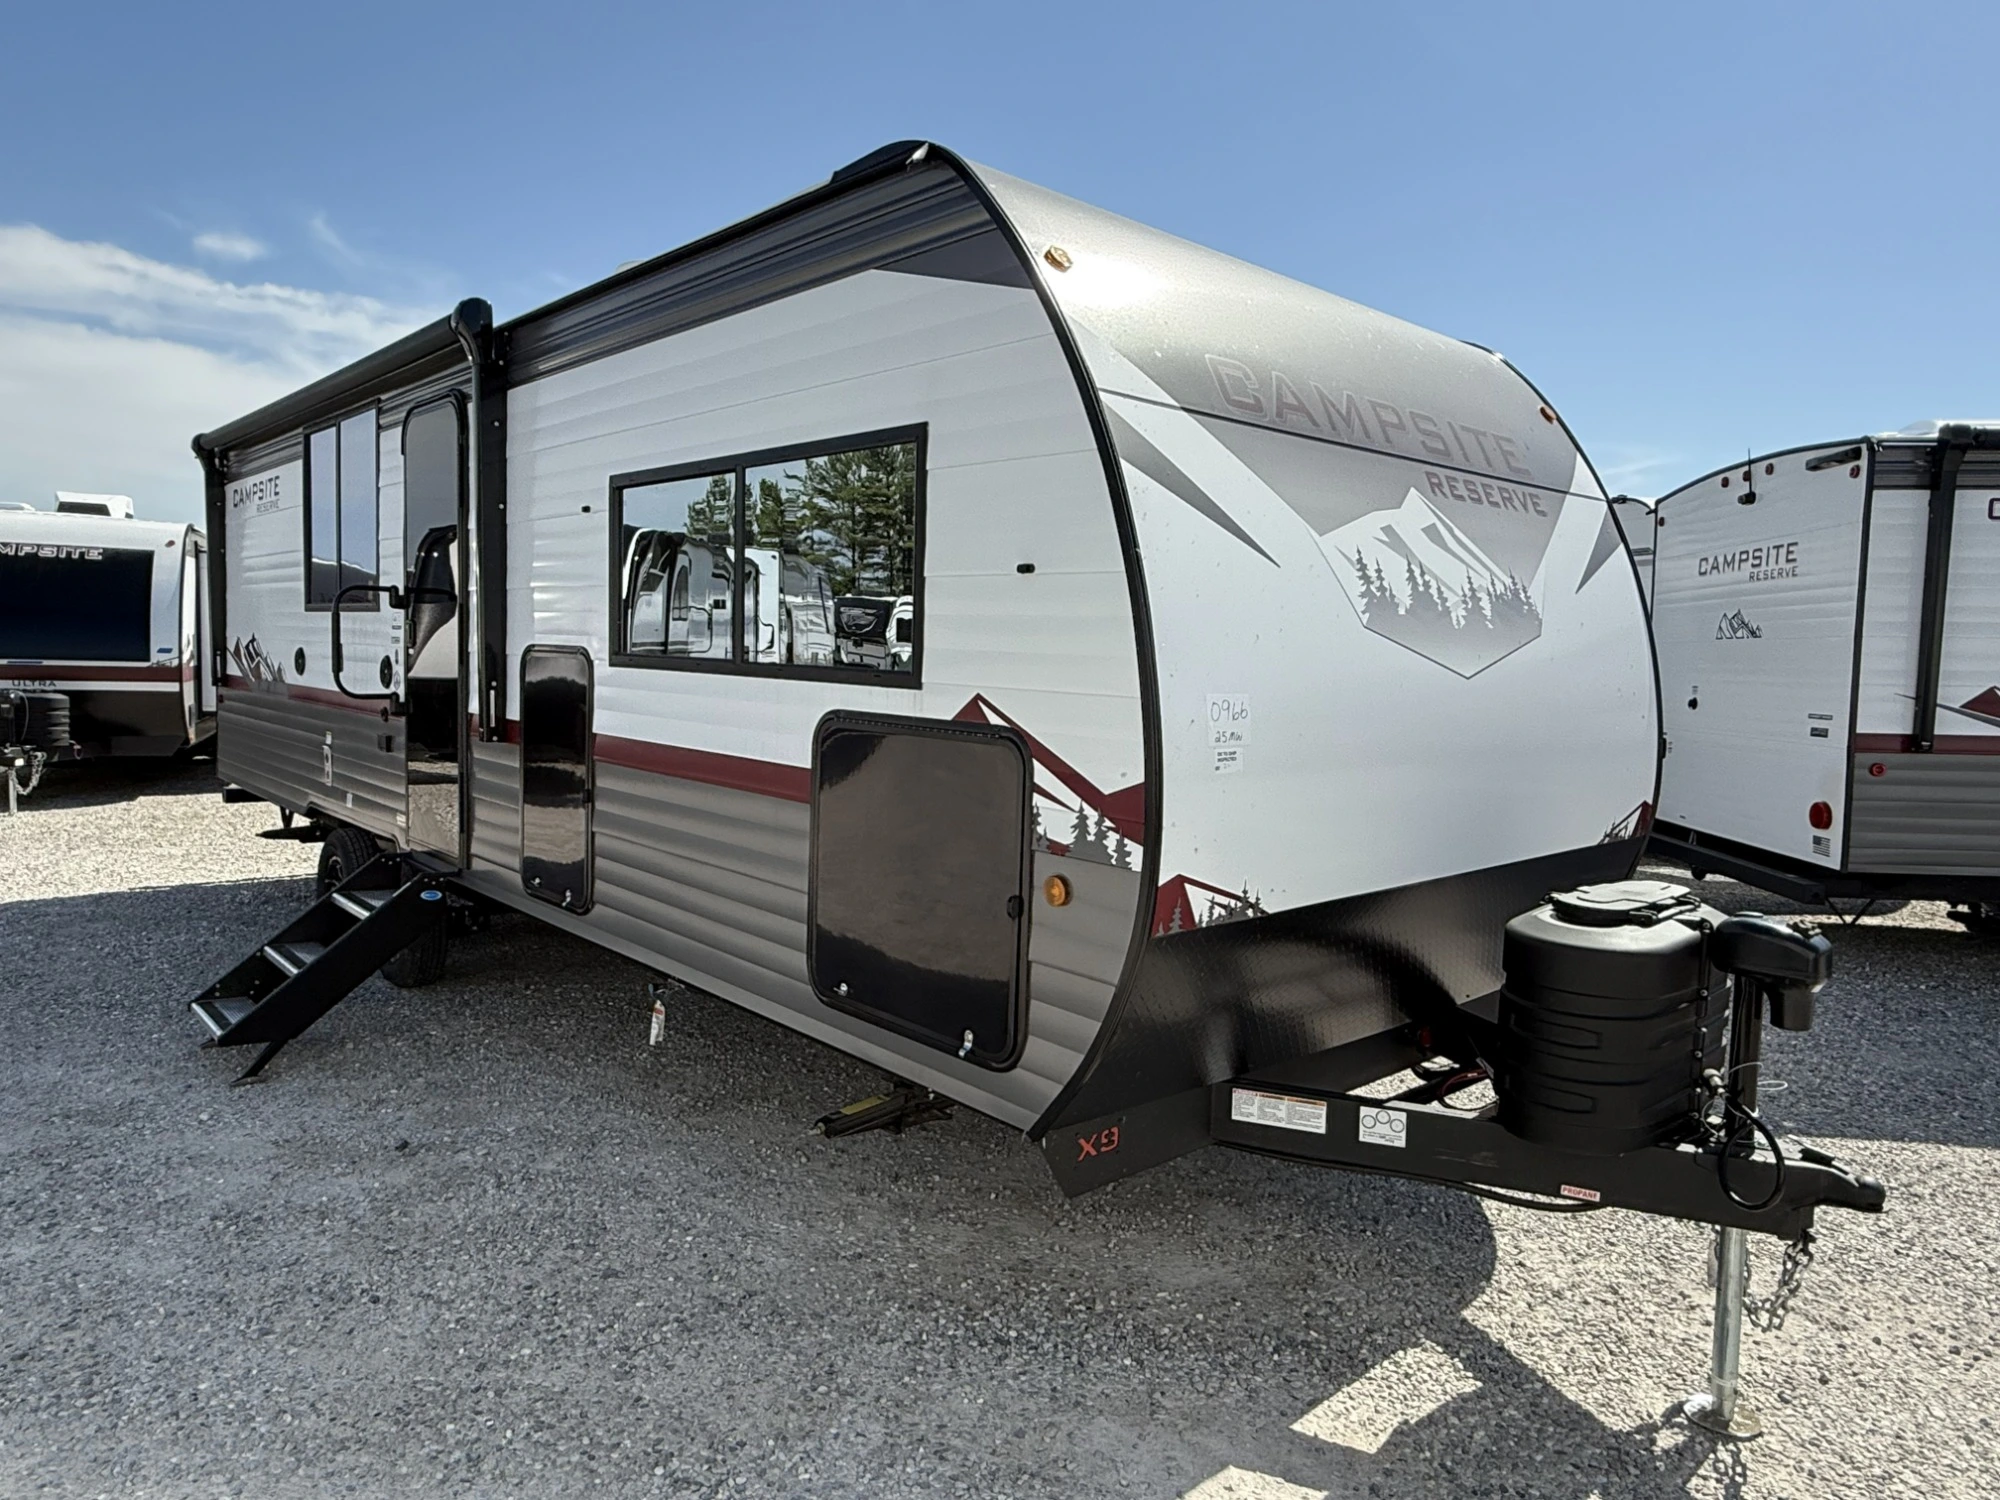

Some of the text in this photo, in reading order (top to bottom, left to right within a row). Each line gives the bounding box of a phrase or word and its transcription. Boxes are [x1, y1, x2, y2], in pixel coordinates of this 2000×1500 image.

[1205, 354, 1532, 478] CAMPSITE
[233, 475, 280, 508] CAMPSITE
[1424, 470, 1549, 517] RESERVE
[1698, 541, 1799, 576] CAMPSITE
[1748, 566, 1799, 582] RESERVE
[11, 679, 57, 688] ULTRA
[1210, 699, 1249, 722] 0966
[1077, 1126, 1119, 1162] X9
[1562, 1186, 1598, 1199] PROPANE
